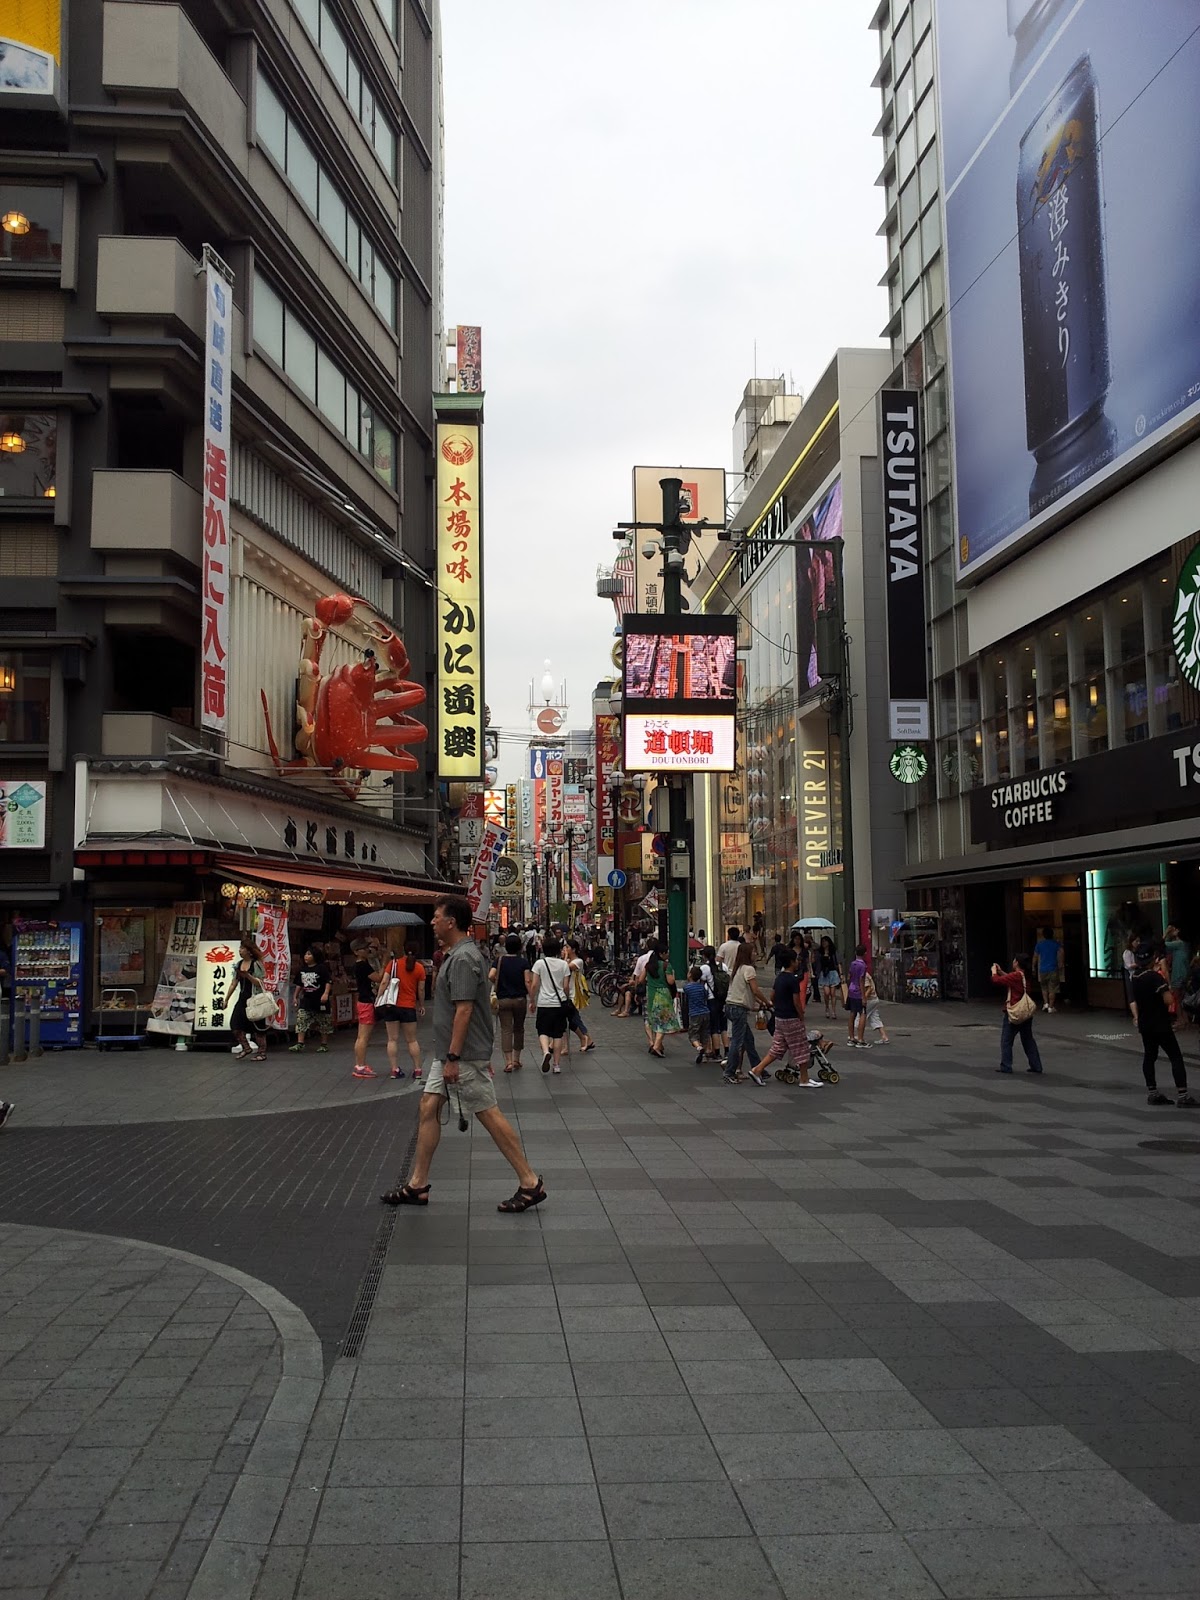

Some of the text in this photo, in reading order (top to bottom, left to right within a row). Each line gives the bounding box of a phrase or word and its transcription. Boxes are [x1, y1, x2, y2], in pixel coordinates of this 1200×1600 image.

[1048, 184, 1070, 369] 澄みきり
[886, 406, 919, 582] TSUTAYA
[444, 477, 473, 584] 本場の味
[204, 438, 227, 718] 活かに入荷
[442, 597, 476, 758] かに道楽
[643, 720, 670, 729] ようこそ
[643, 729, 714, 754] 道頓堀
[651, 756, 709, 764] DOUTONBORI
[991, 770, 1067, 809] STARBUCKS
[803, 750, 829, 881] FOREVER 21
[1004, 800, 1053, 829] COFFEE
[198, 1005, 208, 1027] 本店
[211, 965, 226, 1027] かに道楽
